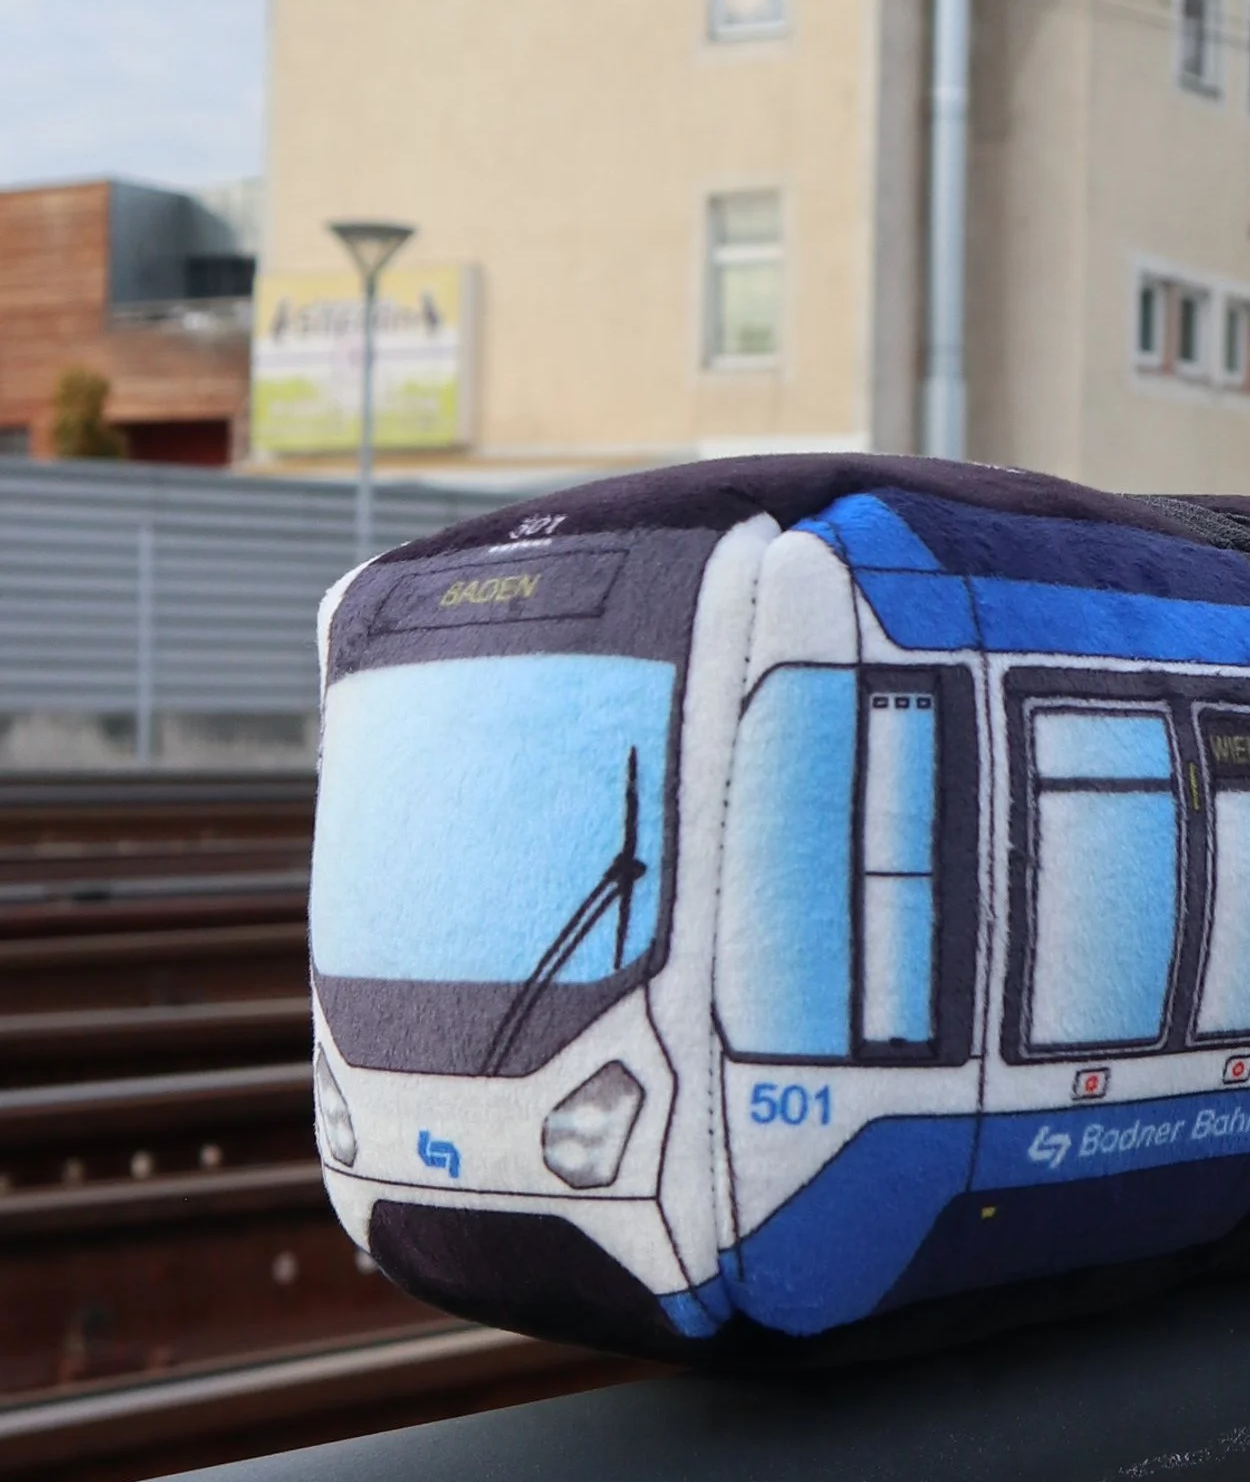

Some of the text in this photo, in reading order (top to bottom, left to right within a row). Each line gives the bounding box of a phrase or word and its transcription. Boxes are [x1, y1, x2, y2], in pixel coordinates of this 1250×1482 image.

[439, 574, 542, 608] BADEN
[750, 1083, 832, 1126] 501
[1078, 1119, 1187, 1158] Badner
